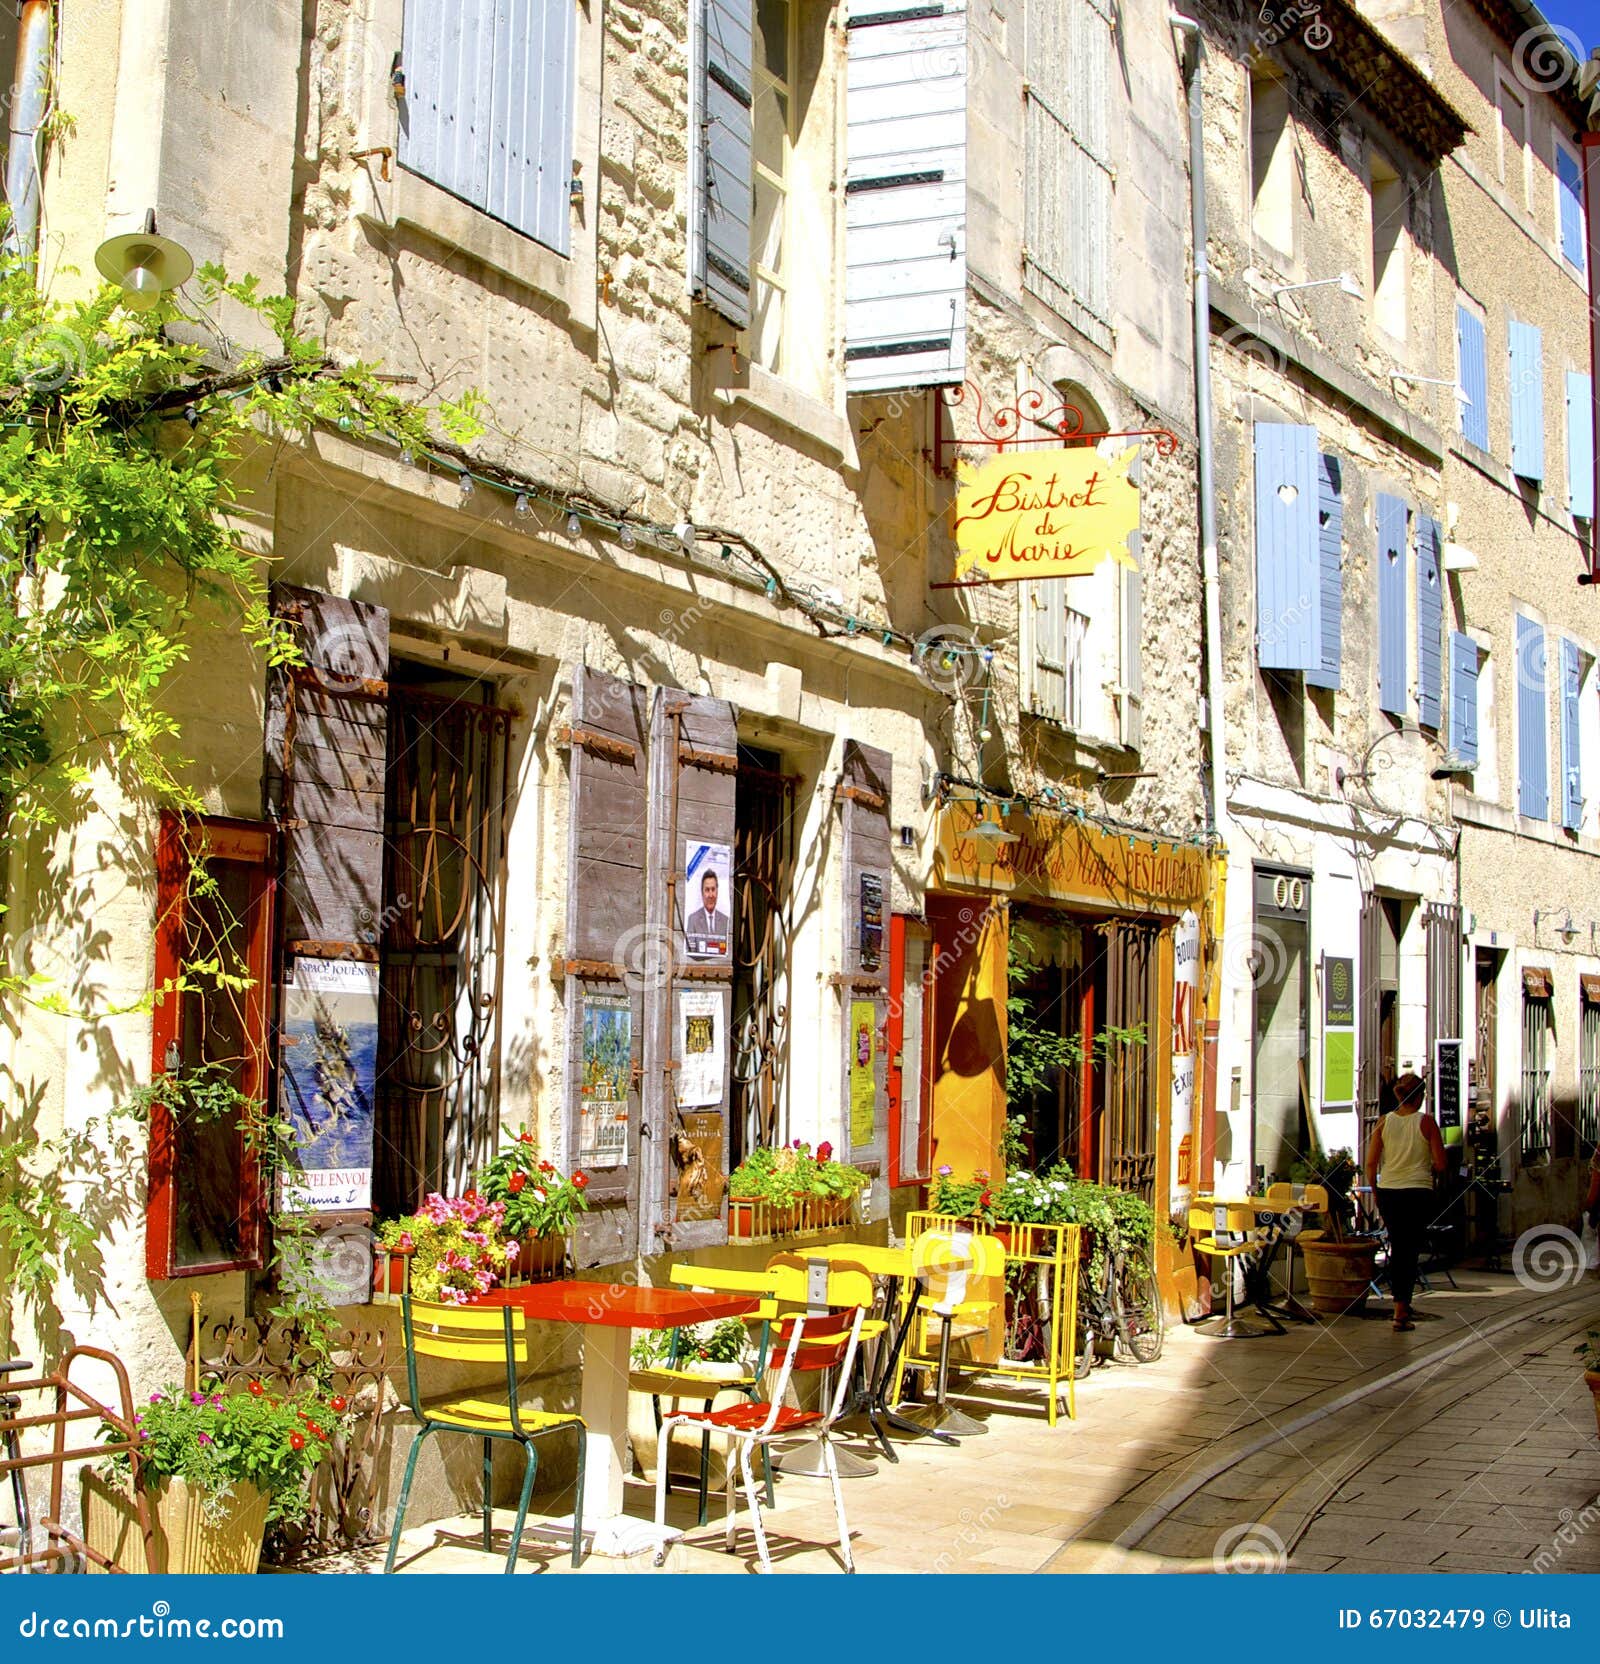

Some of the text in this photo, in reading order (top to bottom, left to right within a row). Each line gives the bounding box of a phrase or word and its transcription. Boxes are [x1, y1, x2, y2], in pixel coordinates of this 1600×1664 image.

[953, 472, 1111, 530] Bistrot
[1035, 512, 1070, 535] de
[986, 513, 1097, 563] Marie
[297, 962, 378, 978] ESPACE JOUENNE
[329, 1171, 368, 1186] ENVOL
